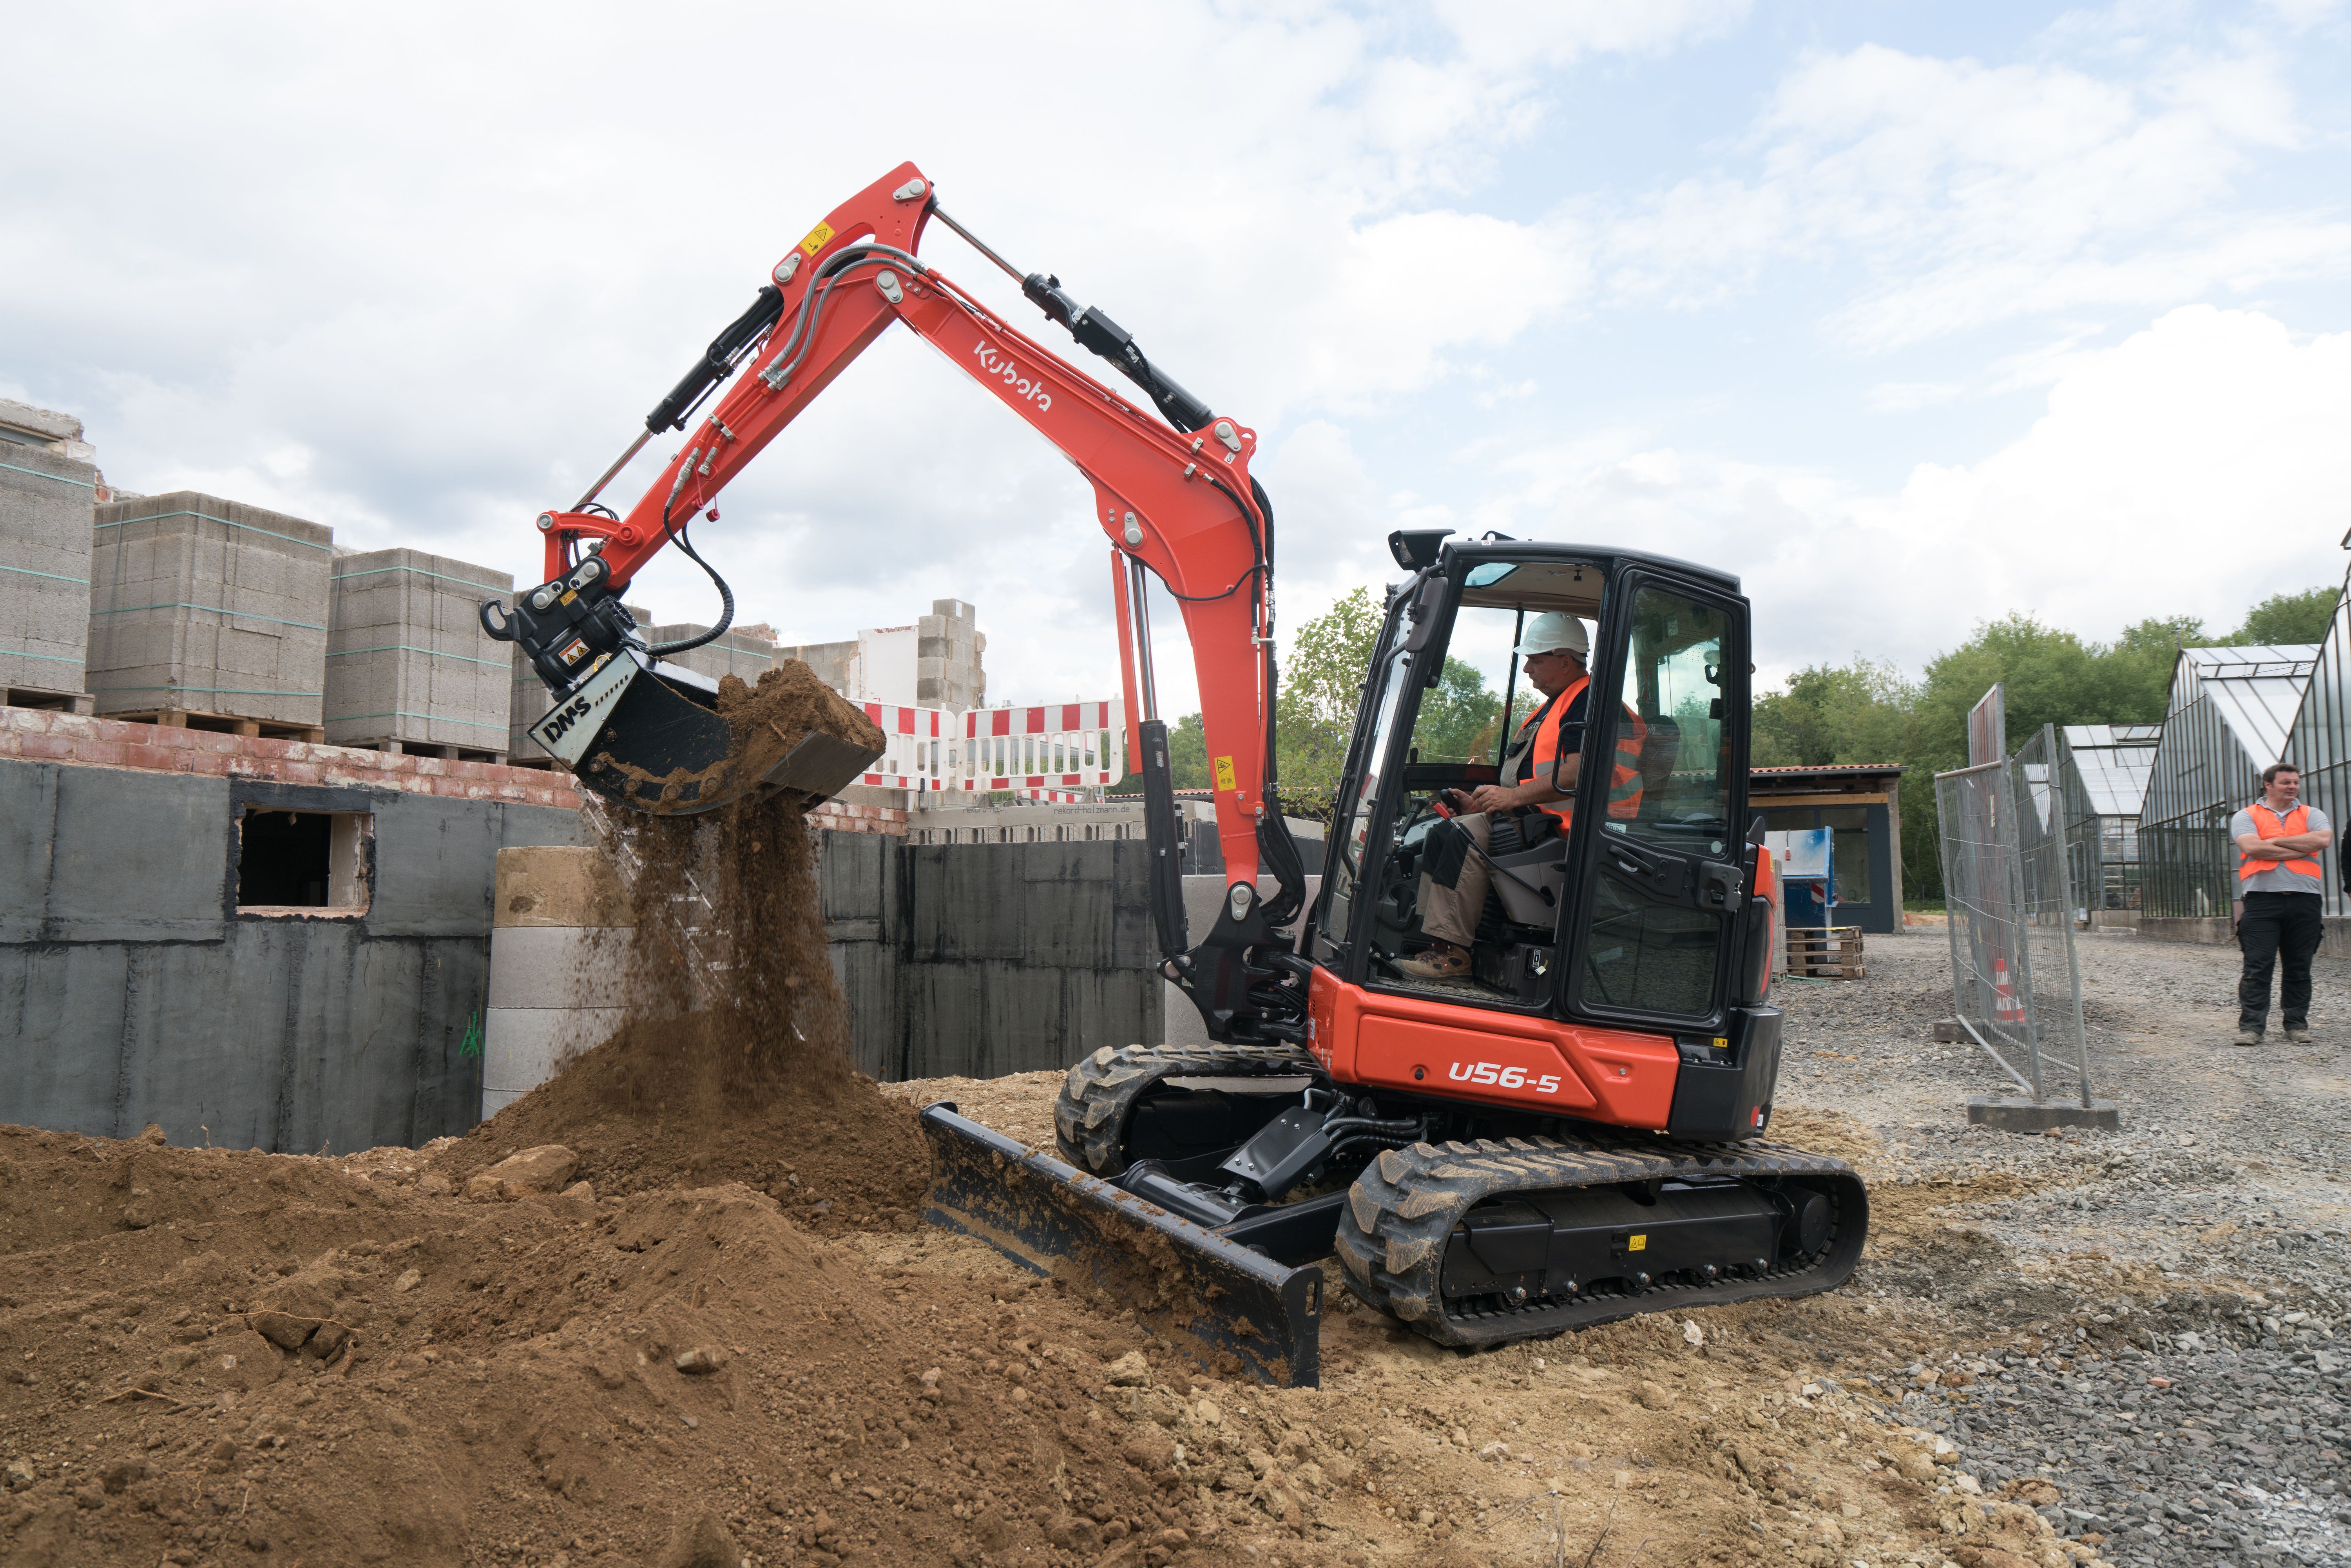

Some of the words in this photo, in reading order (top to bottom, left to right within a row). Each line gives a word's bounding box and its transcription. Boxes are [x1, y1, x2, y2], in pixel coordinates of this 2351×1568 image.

[974, 340, 1052, 412] Kubota
[542, 696, 592, 744] DMS
[1054, 804, 1130, 814] rekord-holzmann.de
[1449, 1062, 1561, 1093] U56-5
